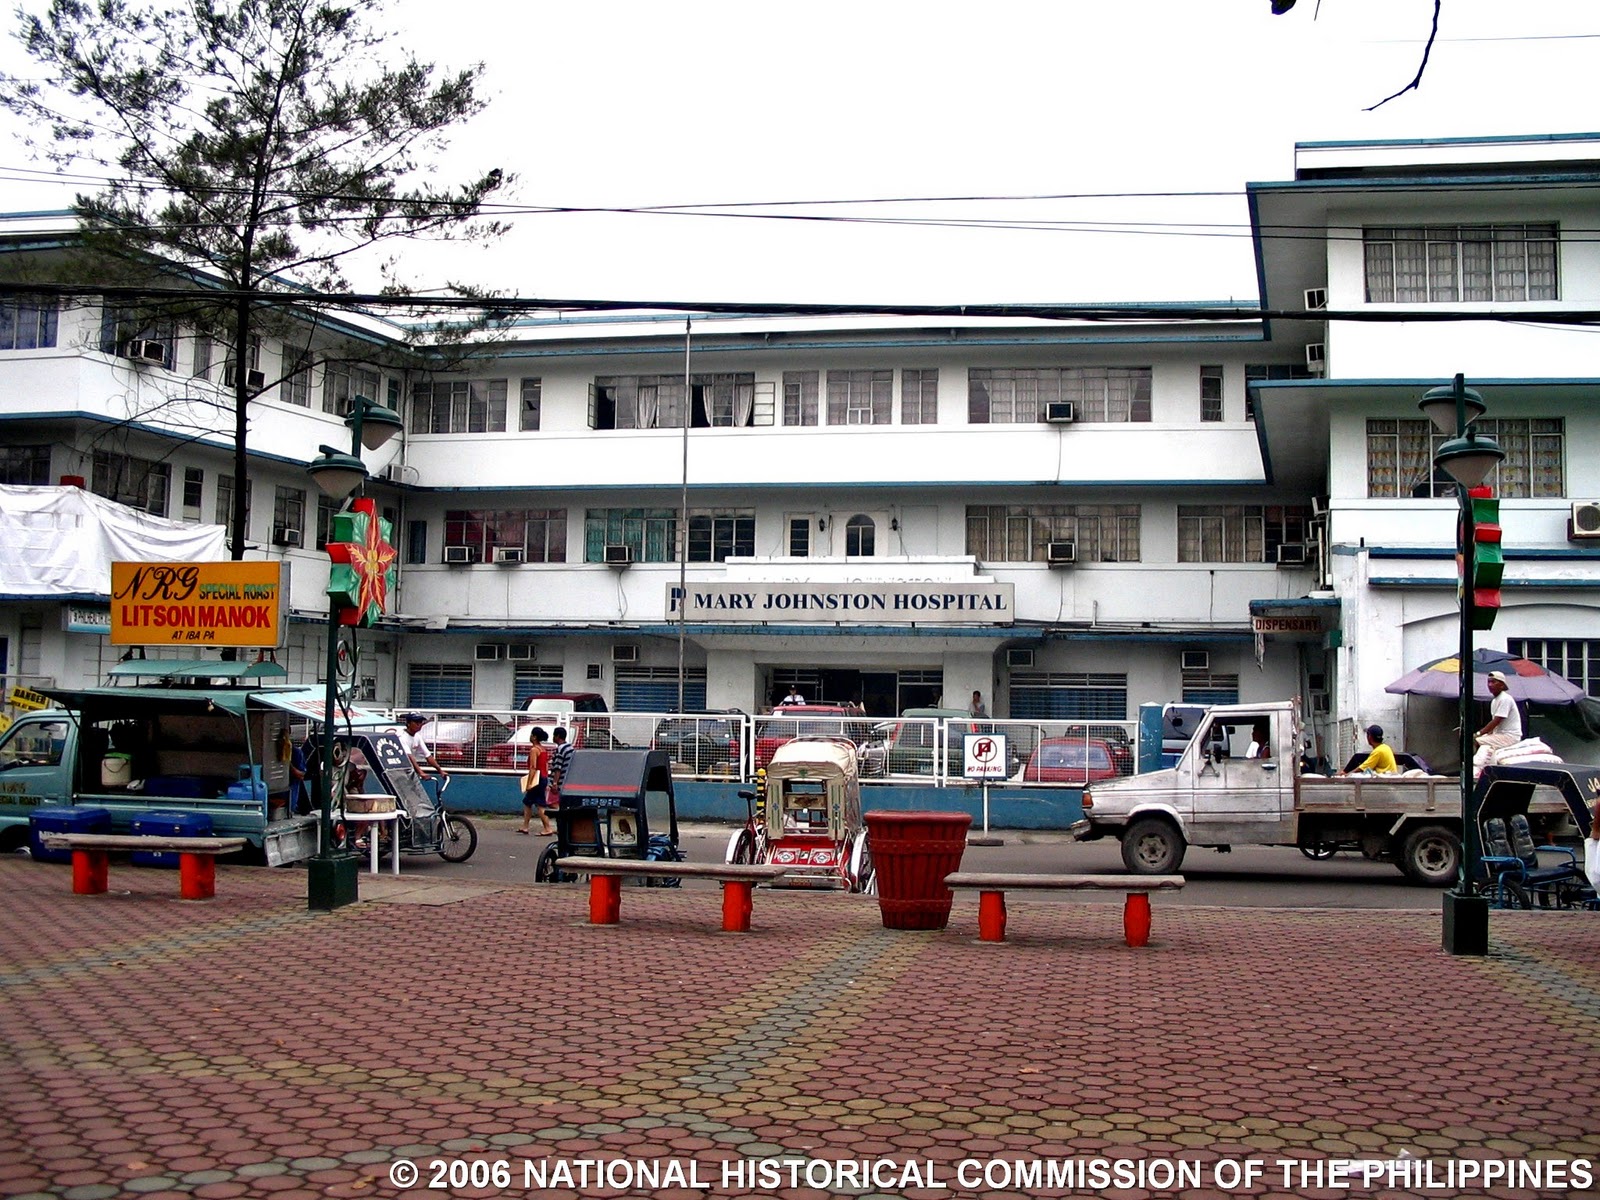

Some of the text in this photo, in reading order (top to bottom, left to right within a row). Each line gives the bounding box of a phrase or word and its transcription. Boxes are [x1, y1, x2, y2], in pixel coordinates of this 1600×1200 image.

[114, 566, 277, 601] NRG SPECIAL ROAST
[694, 593, 757, 609] MARY
[763, 593, 886, 610] JOHNSTON
[894, 593, 1007, 610] HOSPITAL
[122, 604, 196, 627] LITSON
[199, 605, 271, 628] MANOK
[1255, 619, 1318, 631] DISPENSARY
[172, 631, 215, 640] AT IBA PA
